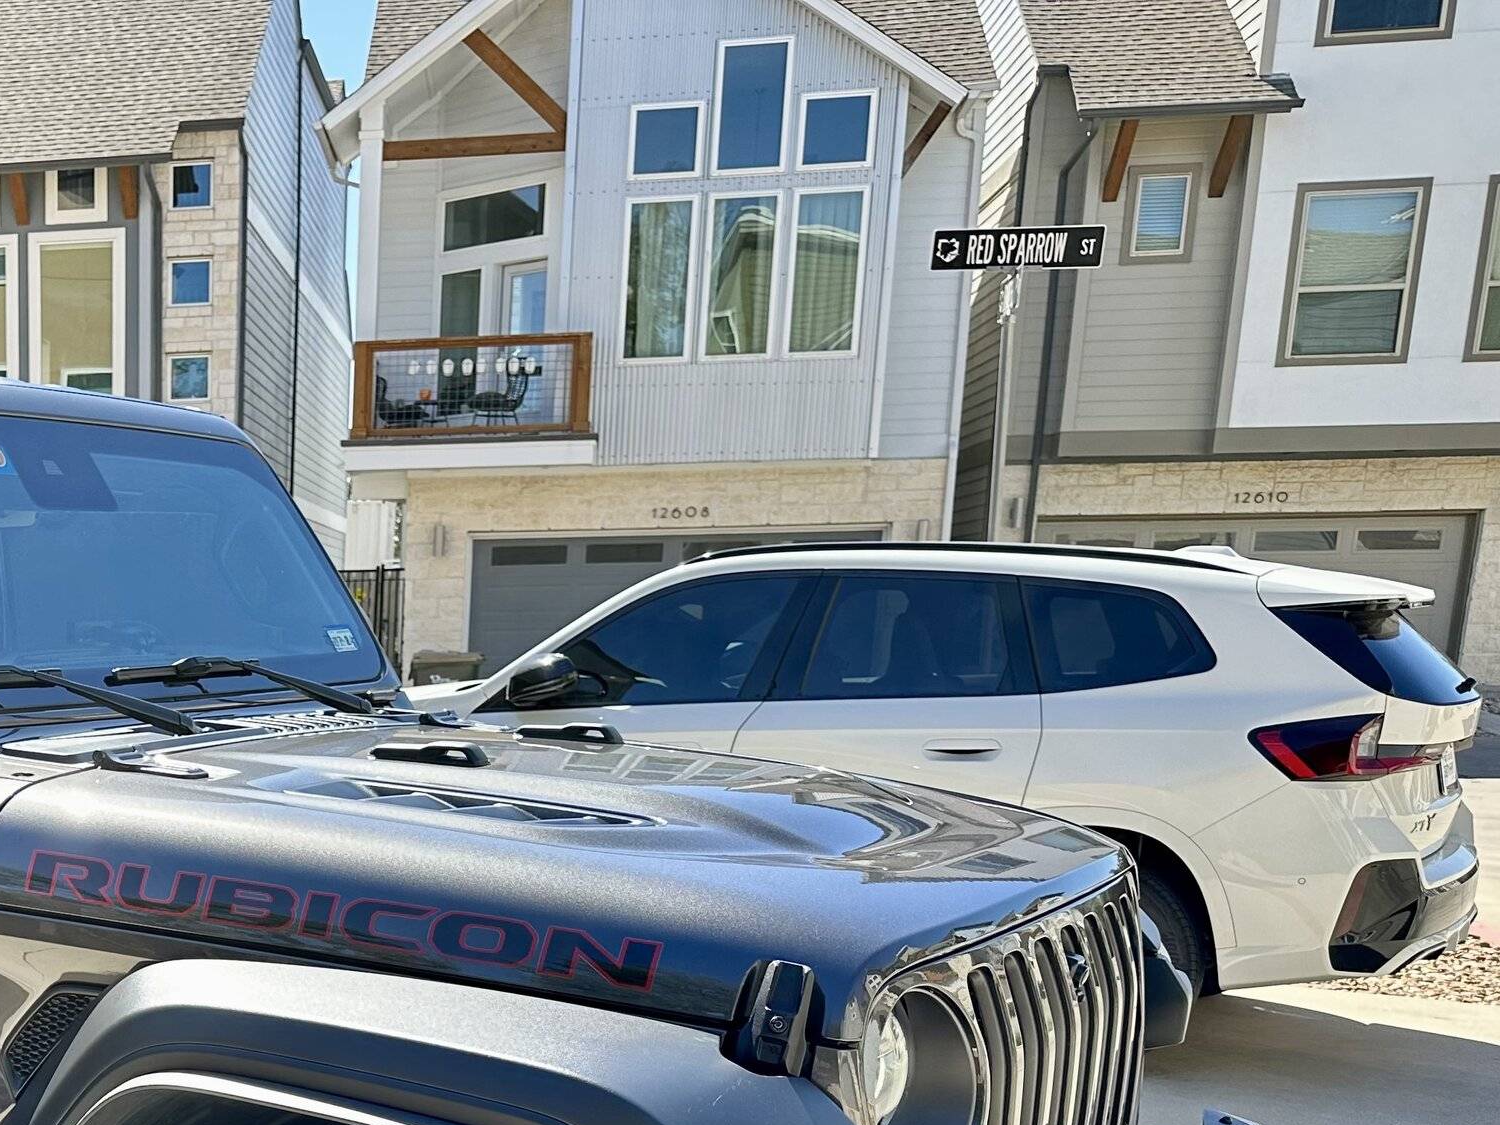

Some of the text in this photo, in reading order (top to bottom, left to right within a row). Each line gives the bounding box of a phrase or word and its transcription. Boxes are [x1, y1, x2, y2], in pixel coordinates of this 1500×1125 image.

[965, 232, 1097, 265] RED SPARROW ST
[1234, 491, 1289, 504] 12610
[651, 506, 710, 519] 12608
[25, 849, 664, 992] RUBICON
